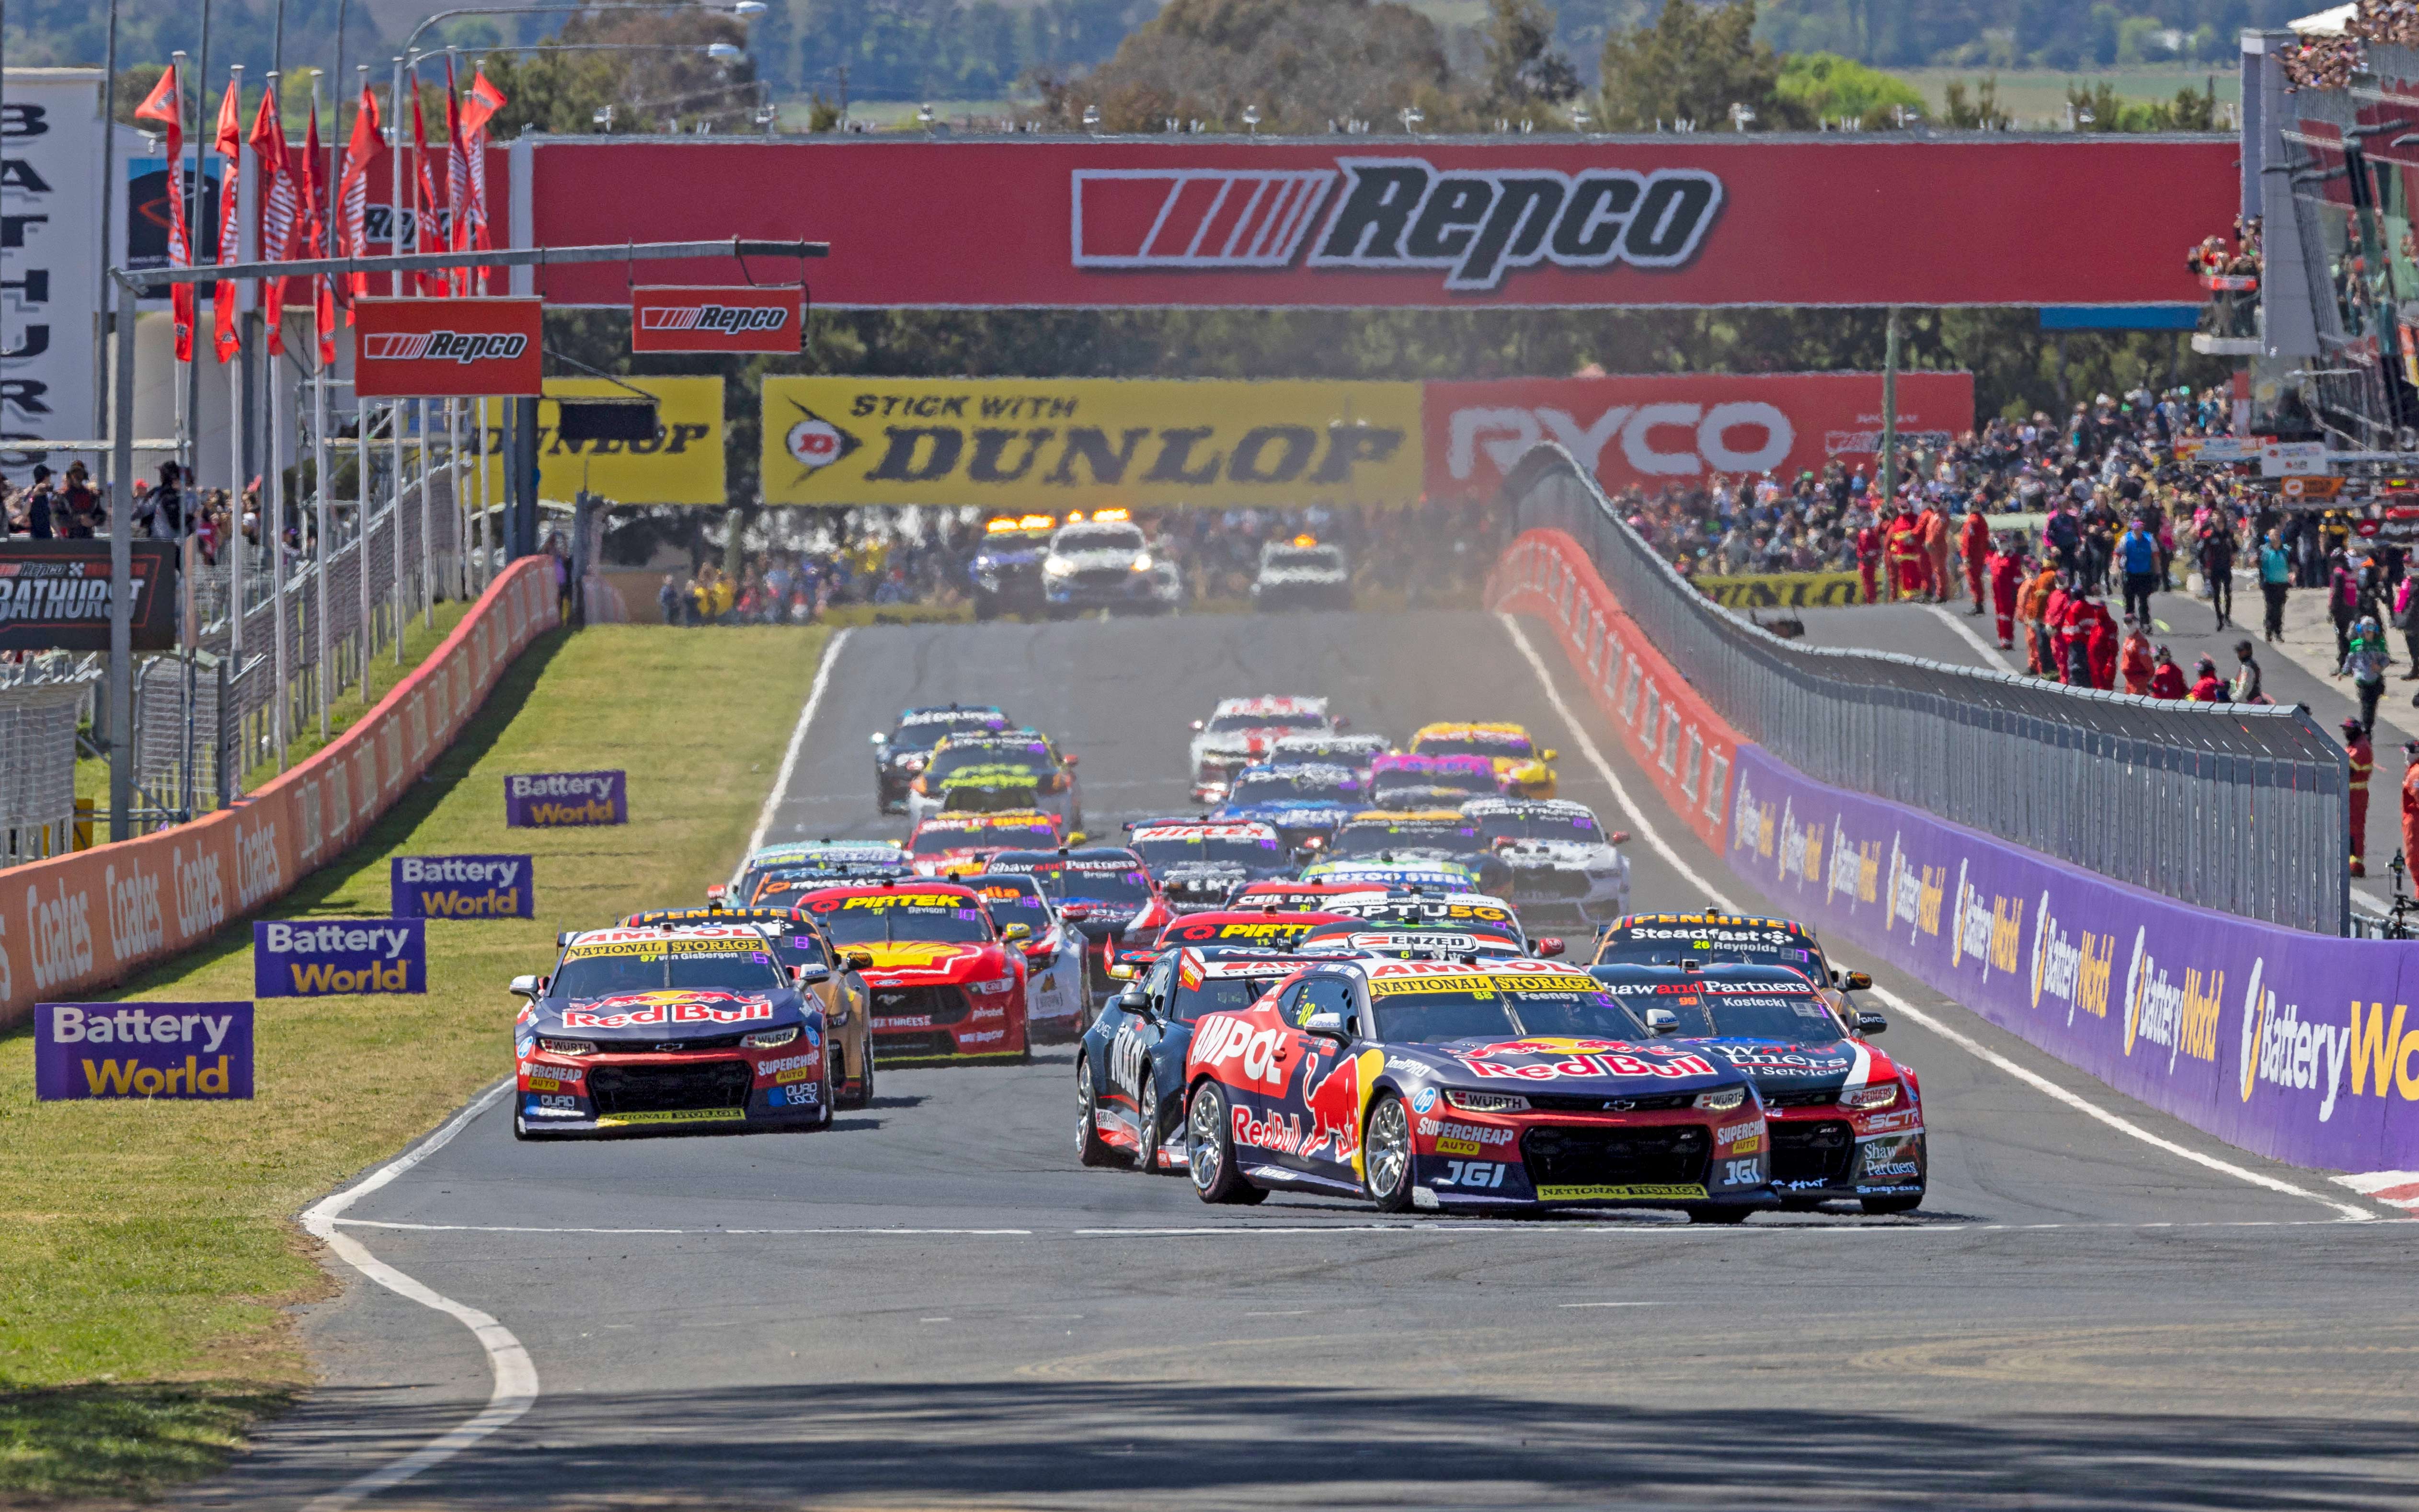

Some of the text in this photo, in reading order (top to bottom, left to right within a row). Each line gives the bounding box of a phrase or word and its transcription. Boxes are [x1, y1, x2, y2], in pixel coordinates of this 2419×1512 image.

[1307, 157, 1723, 289] Repco
[698, 305, 788, 334] Repco
[424, 331, 527, 364] Repco
[850, 394, 1079, 419] STICK WITH
[1446, 401, 1795, 478] RYCO
[865, 425, 1406, 484] DUNLOP
[511, 774, 615, 800] Battery
[531, 799, 614, 824] World
[401, 858, 519, 888] Battery
[173, 840, 225, 938] Coates
[105, 858, 163, 961] Coates
[421, 887, 518, 916] World
[843, 894, 963, 910] PIRTEK
[643, 908, 789, 923] PENRITE
[1634, 913, 1786, 928] PENRITE
[26, 877, 93, 990] Coates
[577, 928, 757, 944] AMPOL
[1219, 924, 1318, 939] PIRT
[1392, 936, 1465, 946] ENZED
[1630, 928, 1759, 942] Steadfast
[267, 924, 409, 959] Battery
[569, 940, 760, 958] NATIONAL STORAGE
[1693, 940, 1777, 953] 26 Reynolds
[640, 954, 657, 962] 97
[680, 952, 738, 961] Gisbergen
[1218, 948, 1359, 957] NUON
[1400, 951, 1410, 959] 6
[291, 960, 407, 993] World
[1185, 971, 1195, 984] AUTO
[1373, 962, 1581, 977] AMPOL
[2043, 918, 2115, 1027] Battery World
[1371, 976, 1597, 994] NATIONAL STORAGE
[1606, 983, 1657, 995] haw
[1703, 981, 1810, 993] Partners
[1472, 991, 1580, 1001] 88 Feeney
[1679, 997, 1787, 1007] 99 Kostecki
[562, 1000, 773, 1029] Red Bull
[1297, 1003, 1316, 1026] 88
[2139, 955, 2185, 1076] Battery
[2180, 967, 2225, 1062] World
[53, 1006, 233, 1053] Battery
[1190, 1015, 1289, 1085] AMPOL
[2259, 990, 2350, 1123] Battery
[757, 1050, 819, 1076] SUPERCHEAP
[1385, 1055, 1431, 1077] ToolPRO
[1458, 1053, 1719, 1081] Red Bull
[1726, 1054, 1848, 1067] tners
[81, 1054, 229, 1095] World
[520, 1061, 582, 1082] SUPERCHEAP
[780, 1070, 803, 1080] AUTO
[1762, 1066, 1849, 1077] Services
[531, 1078, 556, 1088] AUTO
[786, 1082, 817, 1097] QUAD
[787, 1091, 819, 1105] LOCK
[1468, 1094, 1522, 1109] WÜRTH
[1713, 1090, 1744, 1103] WÜRTH
[1861, 1087, 1892, 1102] PEDDERS
[1232, 1104, 1302, 1155] Red Bull
[1417, 1117, 1514, 1146] SUPERCHEAP
[1717, 1117, 1766, 1145] SUPERCHE
[1440, 1141, 1476, 1152] AUTO
[1735, 1140, 1755, 1151] AUTO
[1864, 1142, 1898, 1160] Shaw
[1447, 1161, 1506, 1188] JGI
[1723, 1158, 1761, 1185] JGI
[1866, 1160, 1918, 1176] Partners
[1542, 1184, 1628, 1196] NATIONAL
